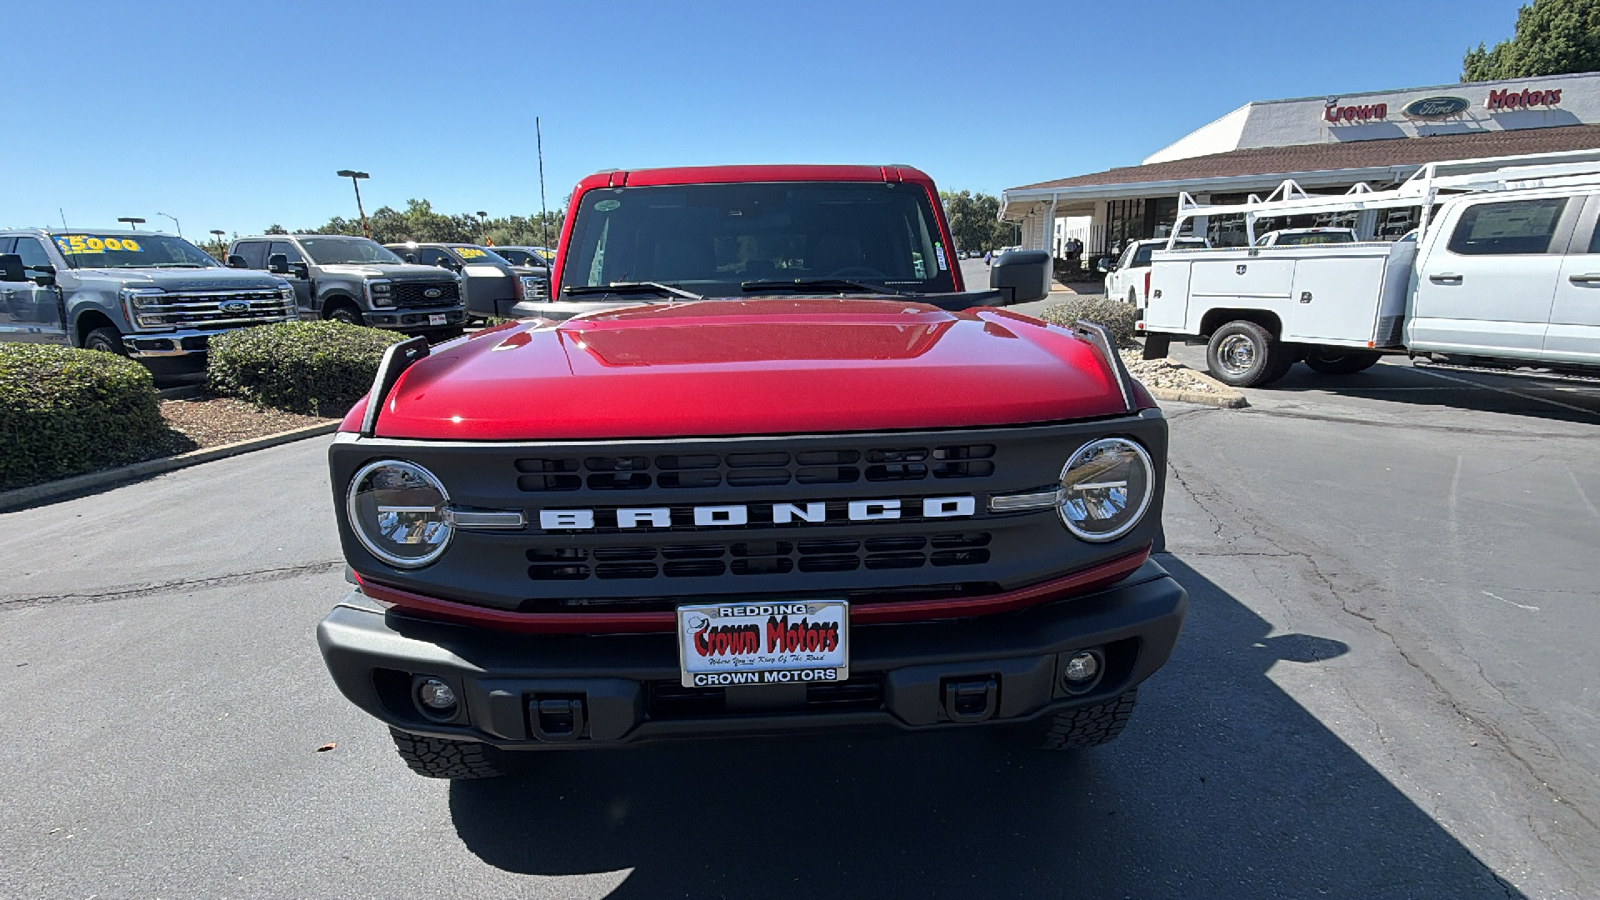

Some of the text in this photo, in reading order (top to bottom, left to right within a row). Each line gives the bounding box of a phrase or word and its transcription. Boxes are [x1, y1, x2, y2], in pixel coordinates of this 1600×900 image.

[1326, 88, 1562, 123] Crown Ford Motors
[539, 496, 976, 529] BRONCO
[719, 604, 807, 618] REDDING
[694, 618, 838, 657] Crown Motors
[758, 656, 776, 664] King
[778, 654, 788, 664] Of
[790, 654, 803, 662] The
[805, 654, 826, 662] Road
[694, 669, 837, 686] CROWN MOTORS
